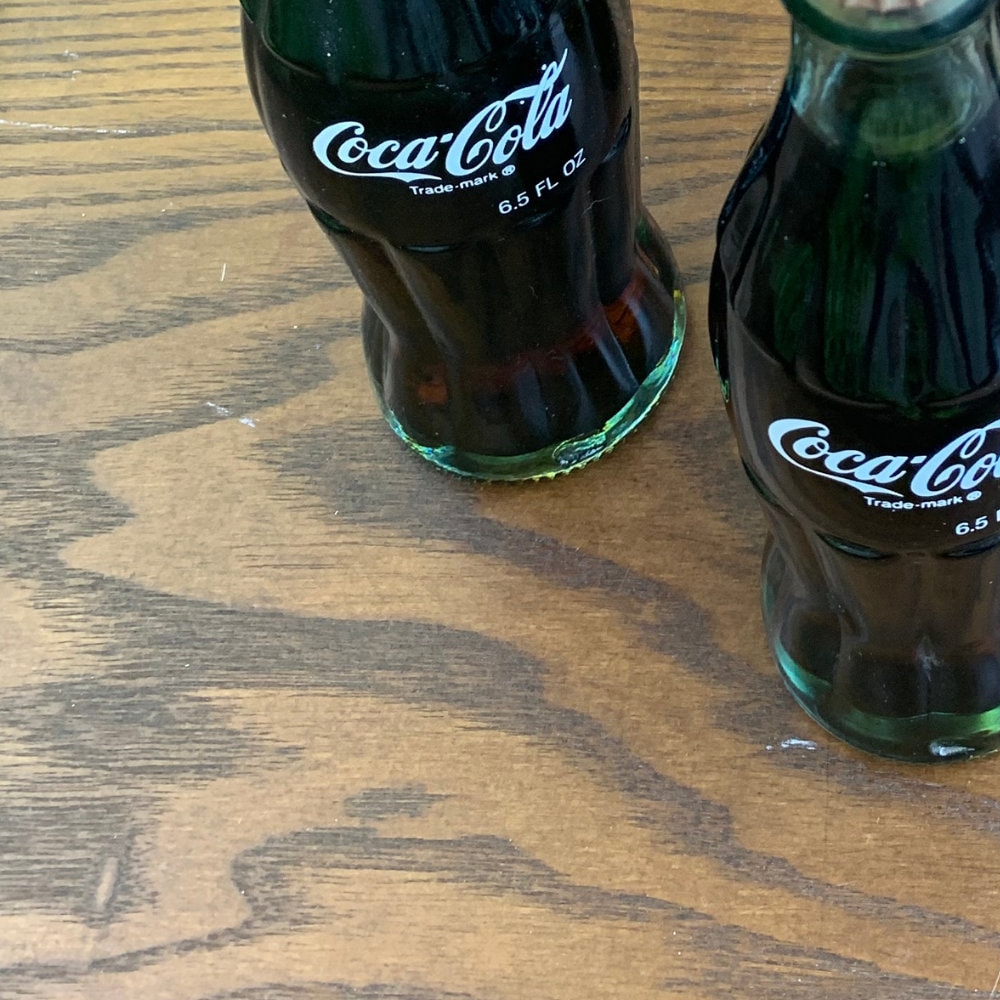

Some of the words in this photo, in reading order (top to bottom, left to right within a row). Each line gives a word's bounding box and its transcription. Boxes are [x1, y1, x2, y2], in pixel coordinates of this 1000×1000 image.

[312, 48, 573, 183] Coca-Cola
[498, 191, 530, 215] 6.5
[535, 178, 559, 198] FL
[562, 148, 587, 177] OZ
[955, 515, 989, 536] 6.5
